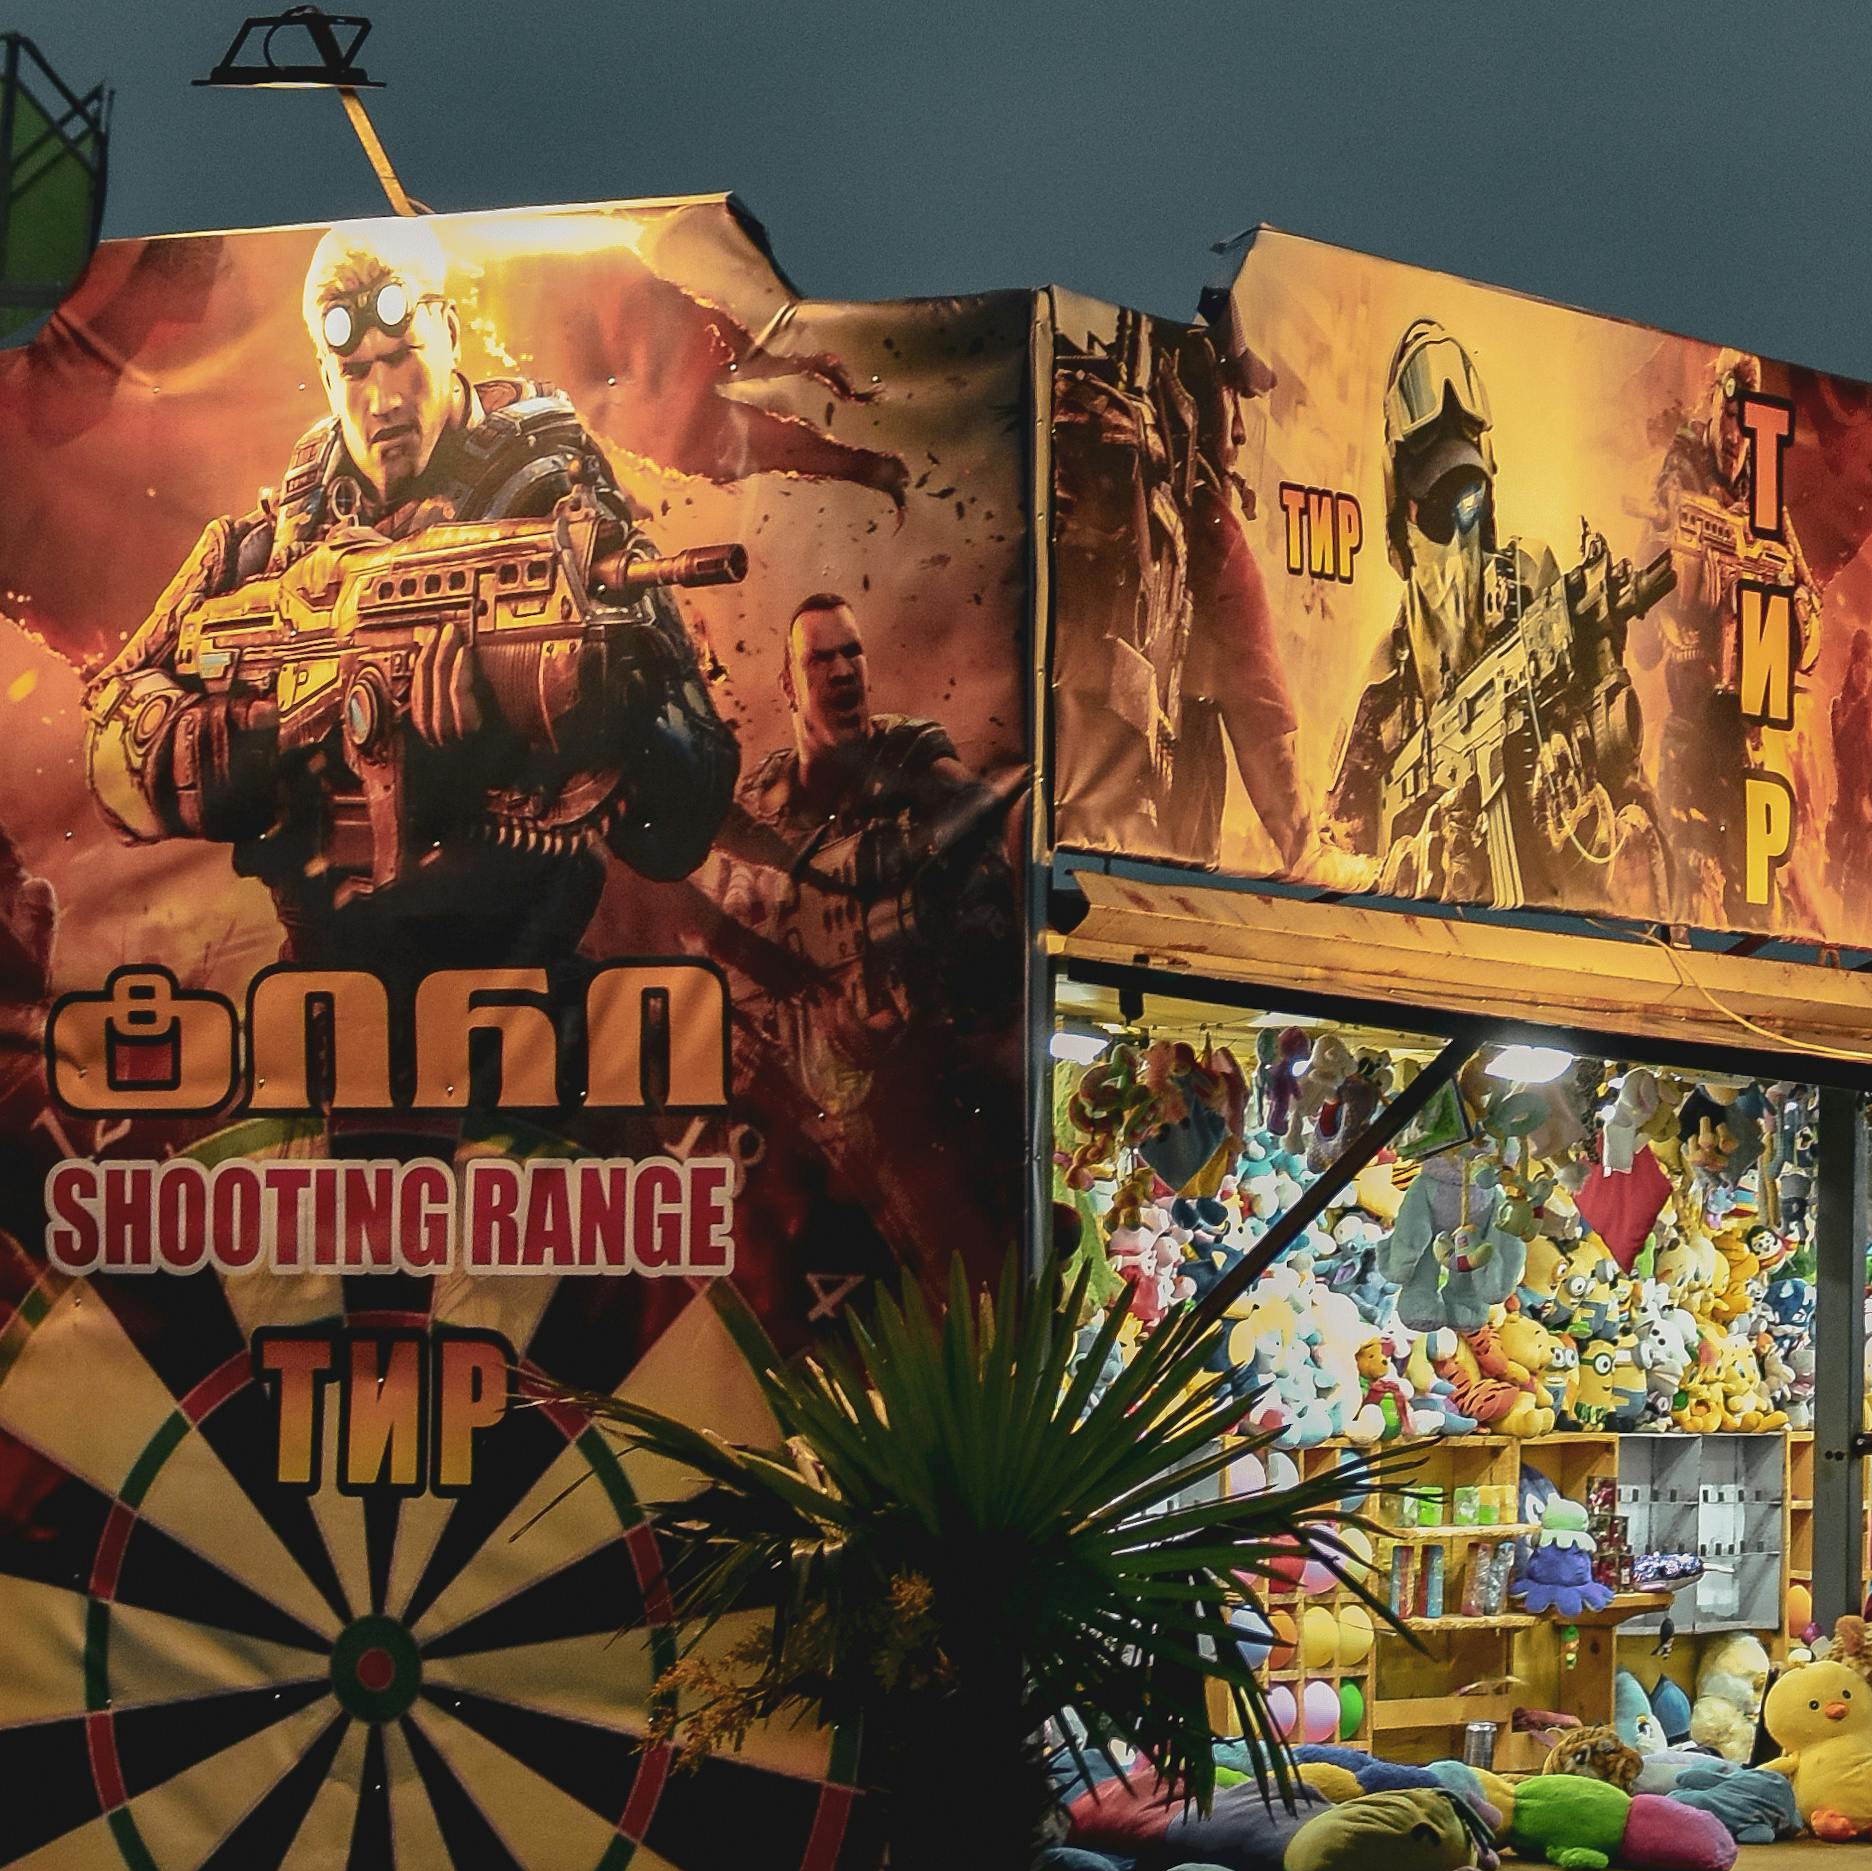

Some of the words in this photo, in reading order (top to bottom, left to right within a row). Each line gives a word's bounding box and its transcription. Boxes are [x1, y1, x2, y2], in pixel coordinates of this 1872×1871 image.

[1280, 485, 1362, 583] ТИР
[1743, 401, 1791, 905] ТИР
[51, 1164, 450, 1268] SHOOTING
[471, 1164, 733, 1268] RANGE
[261, 1340, 509, 1485] ТИР
